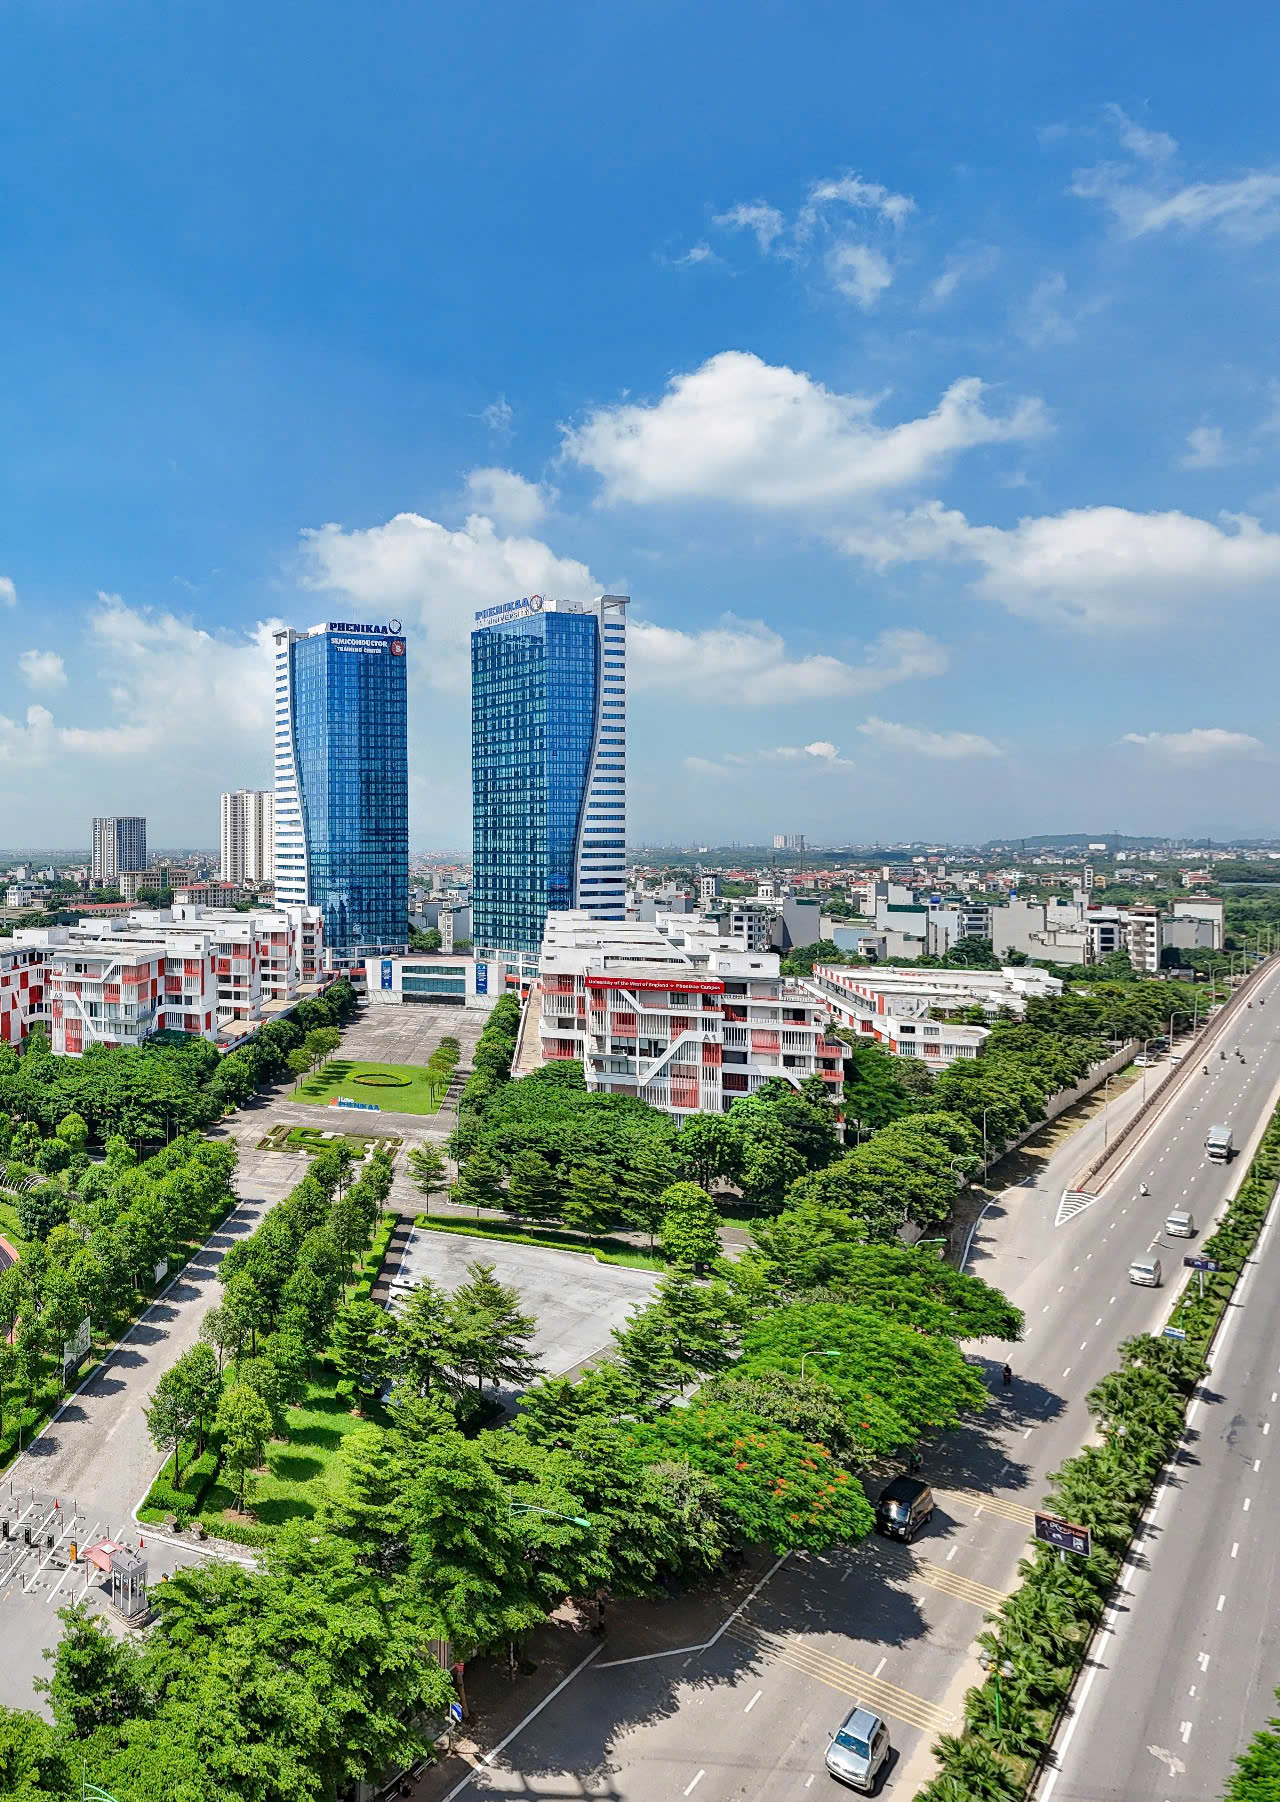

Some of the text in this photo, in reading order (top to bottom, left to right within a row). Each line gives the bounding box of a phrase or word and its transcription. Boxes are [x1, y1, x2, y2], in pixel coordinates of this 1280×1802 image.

[475, 598, 529, 620] PHENIKAA
[329, 622, 388, 634] PHENIKAA
[330, 638, 387, 647] SEMICONDUCTOR
[702, 1033, 717, 1042] A1
[338, 1101, 380, 1110] PHENIKAA
